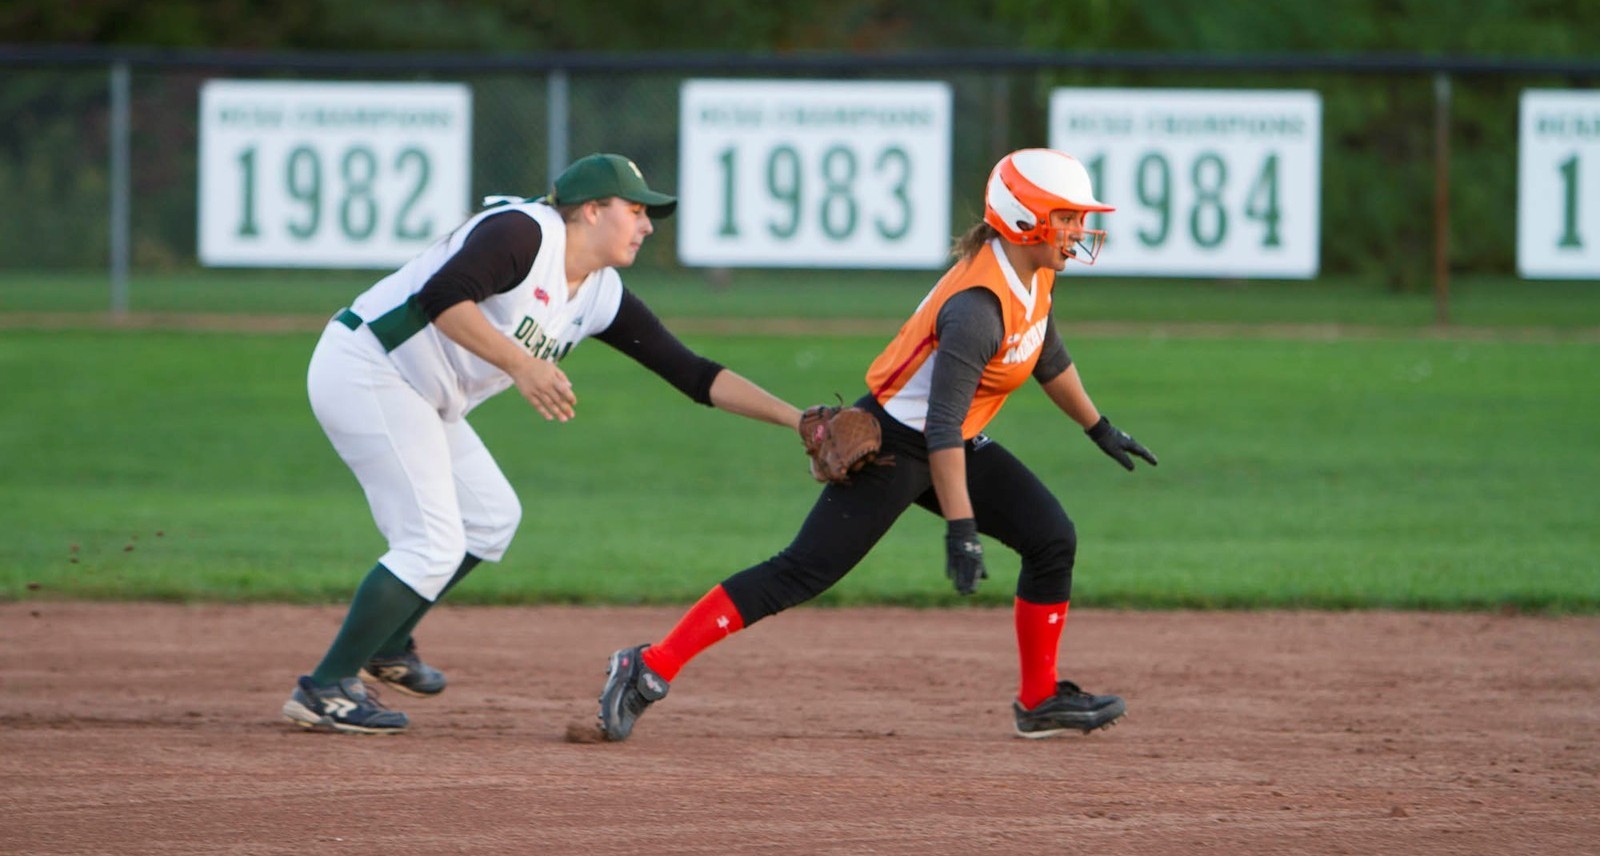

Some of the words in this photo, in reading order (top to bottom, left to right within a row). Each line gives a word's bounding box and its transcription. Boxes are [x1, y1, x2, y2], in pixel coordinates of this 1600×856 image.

[236, 146, 433, 240] 1982
[717, 146, 914, 240] 1983
[1087, 151, 1282, 248] 1984
